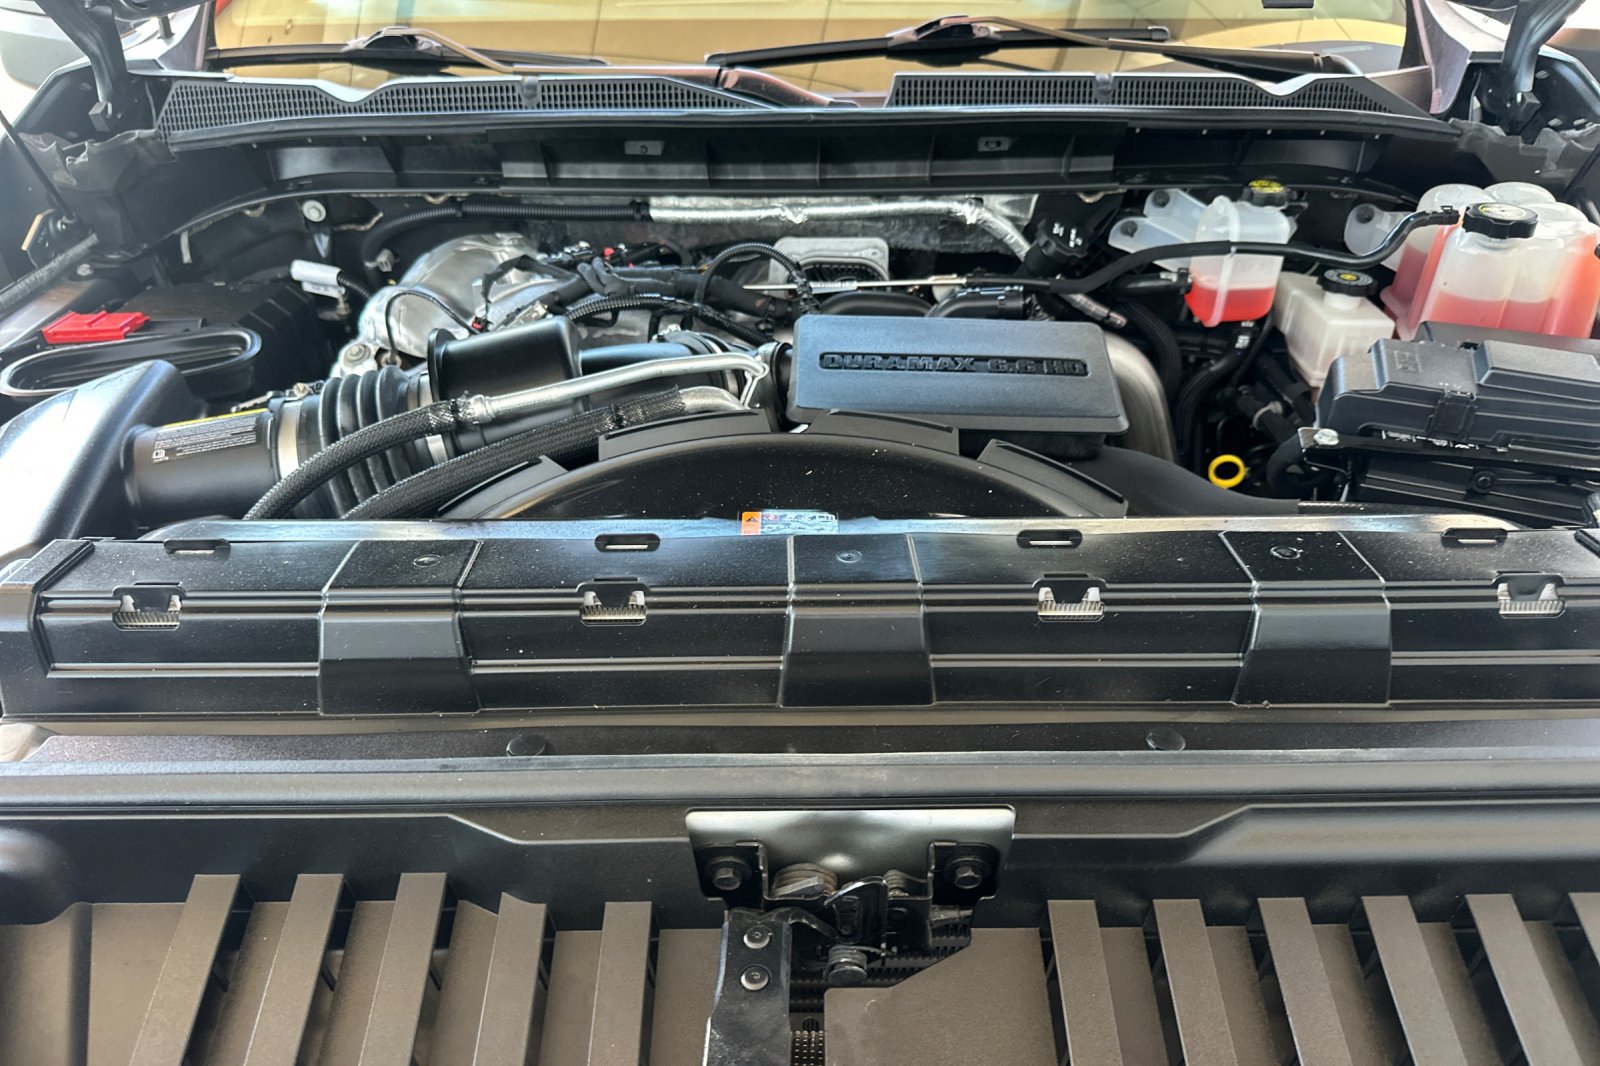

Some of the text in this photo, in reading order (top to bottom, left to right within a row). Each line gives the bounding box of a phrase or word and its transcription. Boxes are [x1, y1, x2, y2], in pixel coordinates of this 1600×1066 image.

[823, 354, 1085, 374] DURAMAX 6.6 HD
